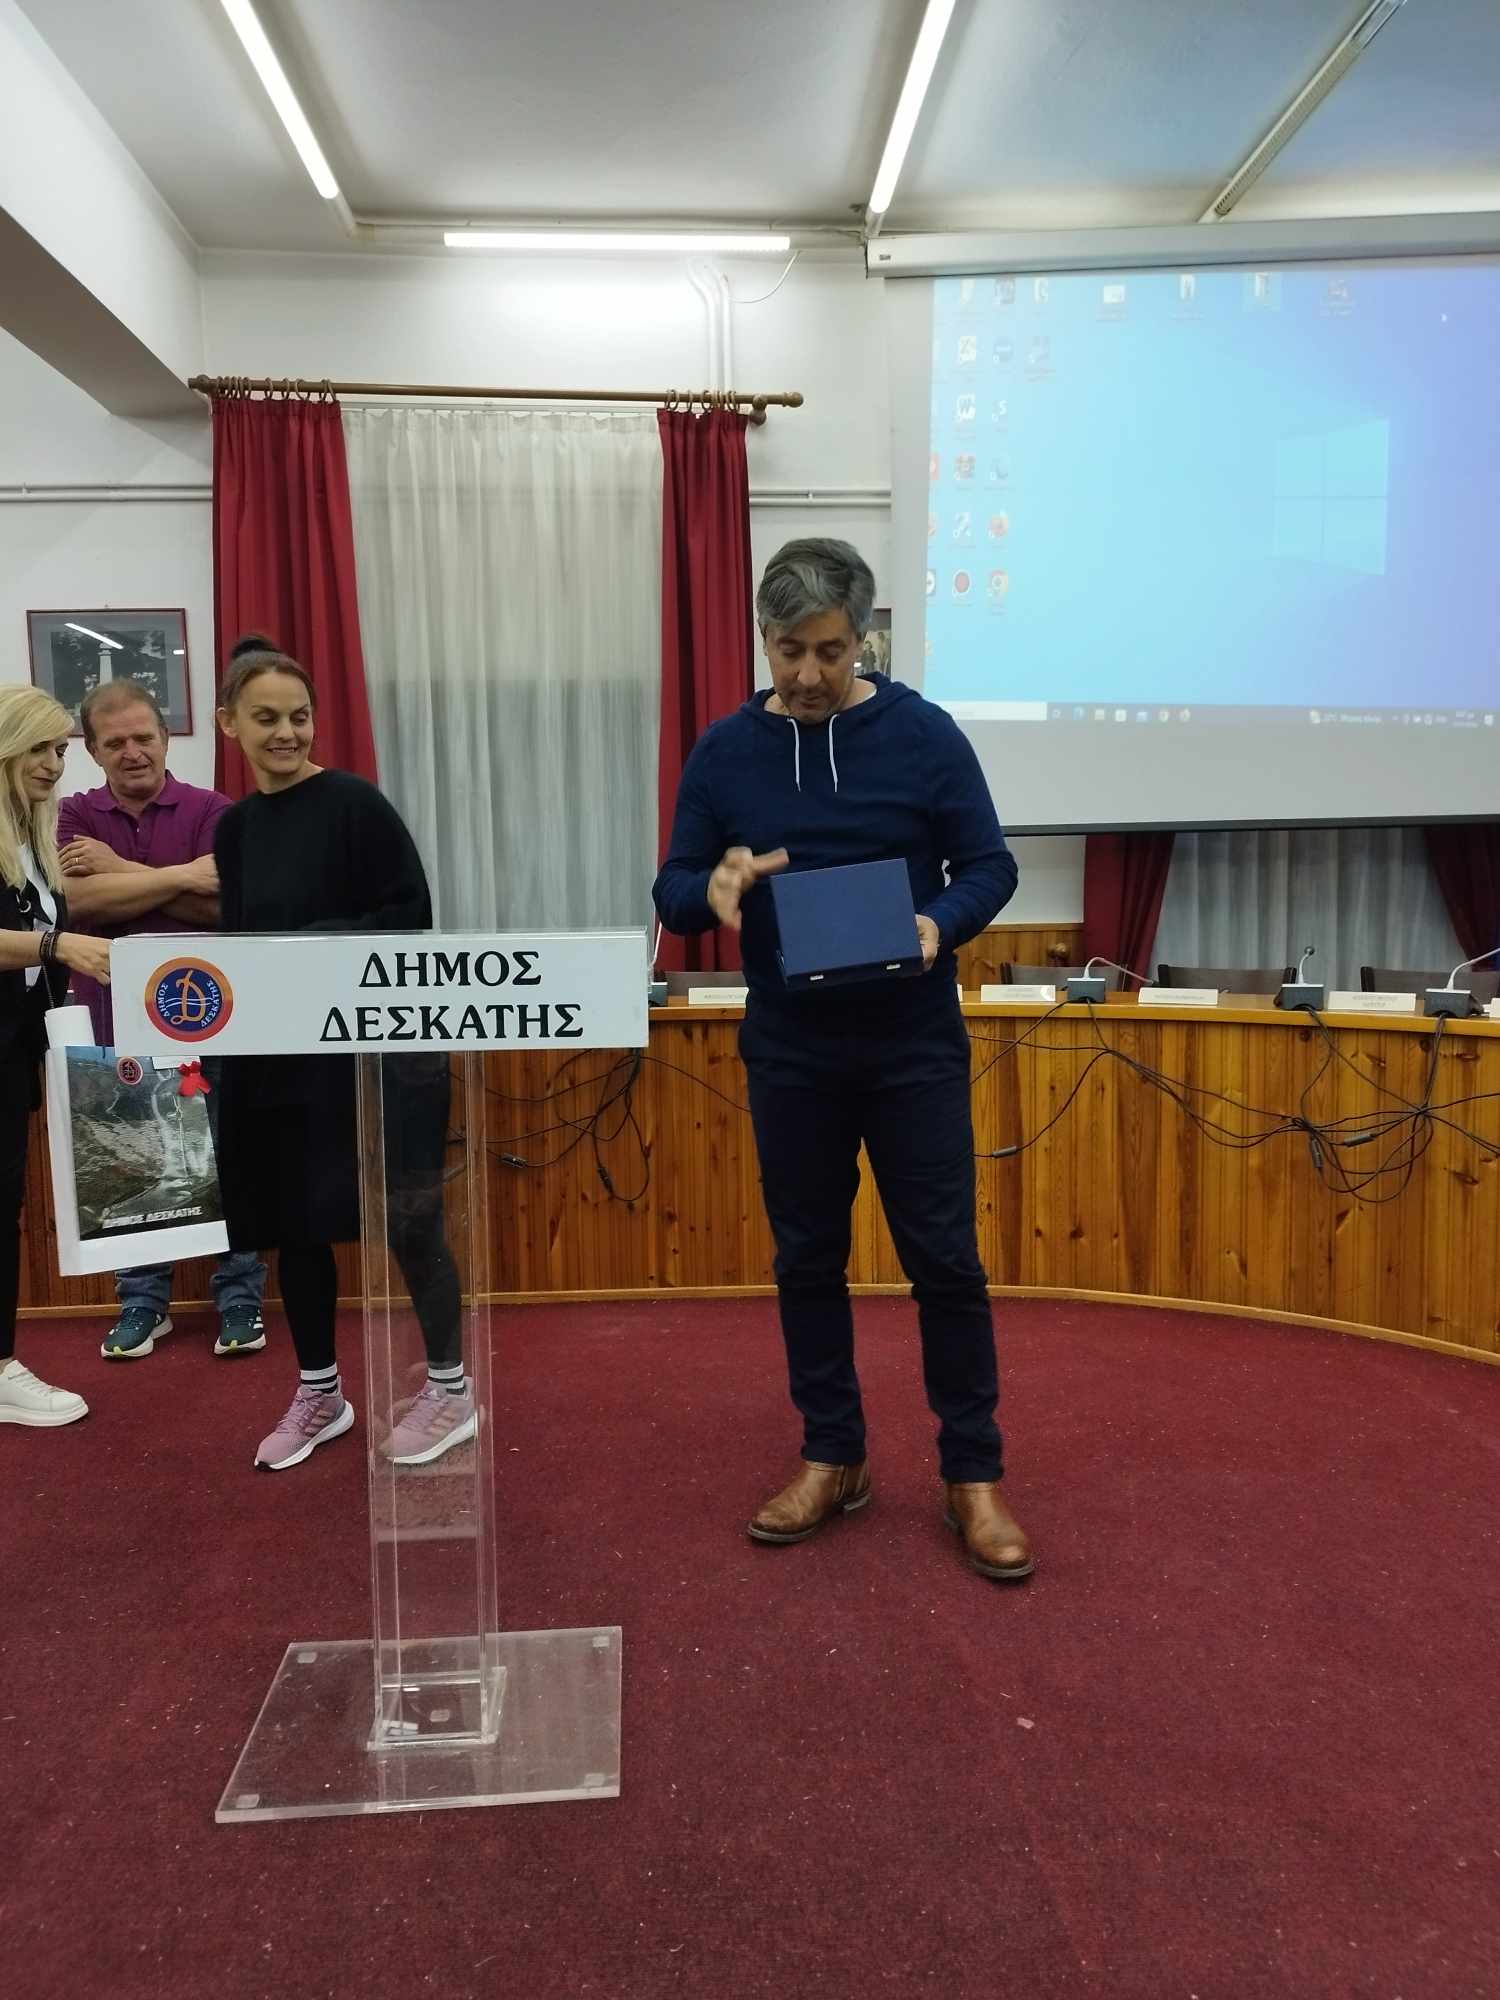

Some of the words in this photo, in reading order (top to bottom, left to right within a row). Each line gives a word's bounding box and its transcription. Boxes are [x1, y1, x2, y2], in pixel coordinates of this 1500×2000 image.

[359, 950, 542, 988] ΔΗΜΟΣ
[157, 982, 170, 1017] ΔΗΜΟΣ
[200, 979, 220, 1027] ΔΕΣΚΑΤΗΣ
[319, 1003, 584, 1042] ΔΕΣΚΑΤΗΣ
